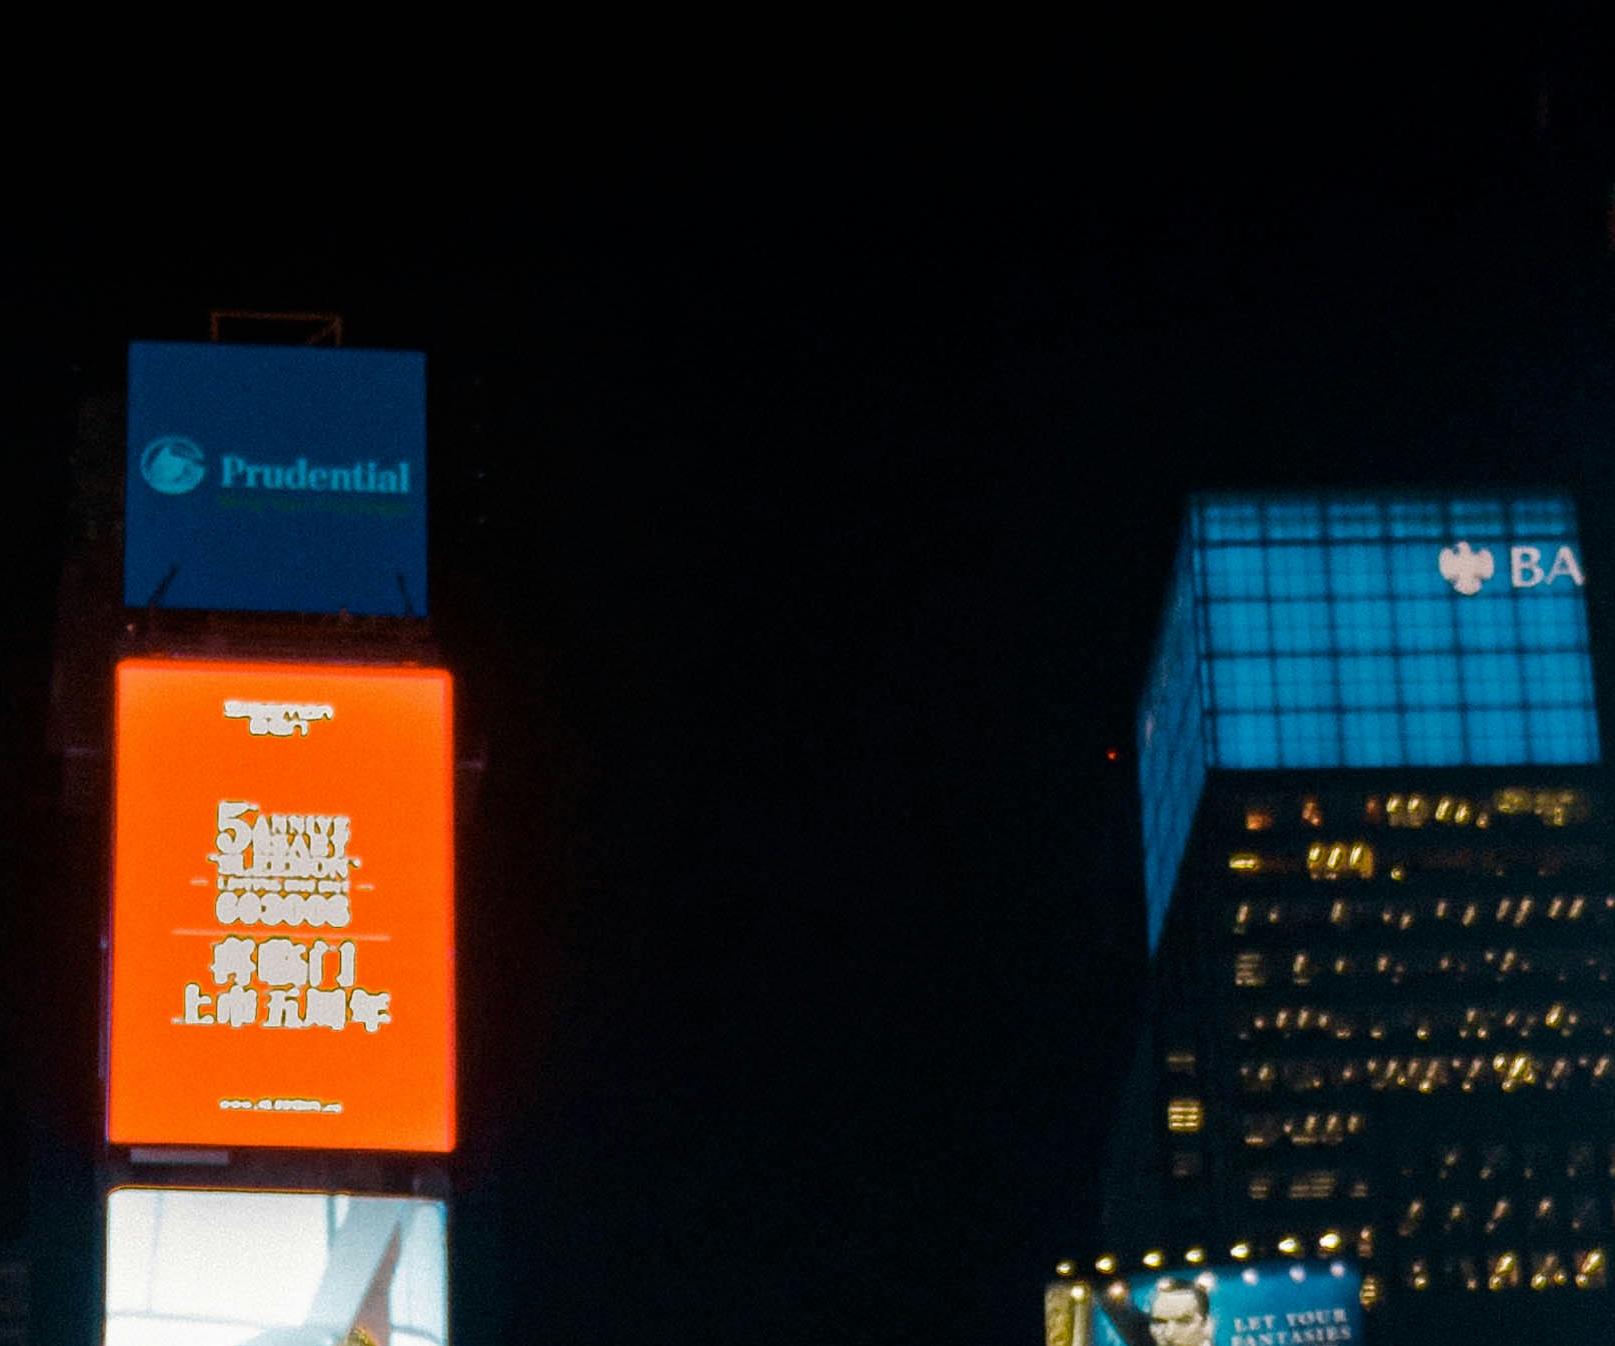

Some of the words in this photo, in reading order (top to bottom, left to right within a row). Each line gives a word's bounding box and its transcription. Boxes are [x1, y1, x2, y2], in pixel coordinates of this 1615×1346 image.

[220, 455, 412, 494] Prudential
[1234, 1313, 1275, 1334] LET
[1286, 1308, 1347, 1328] YOUR
